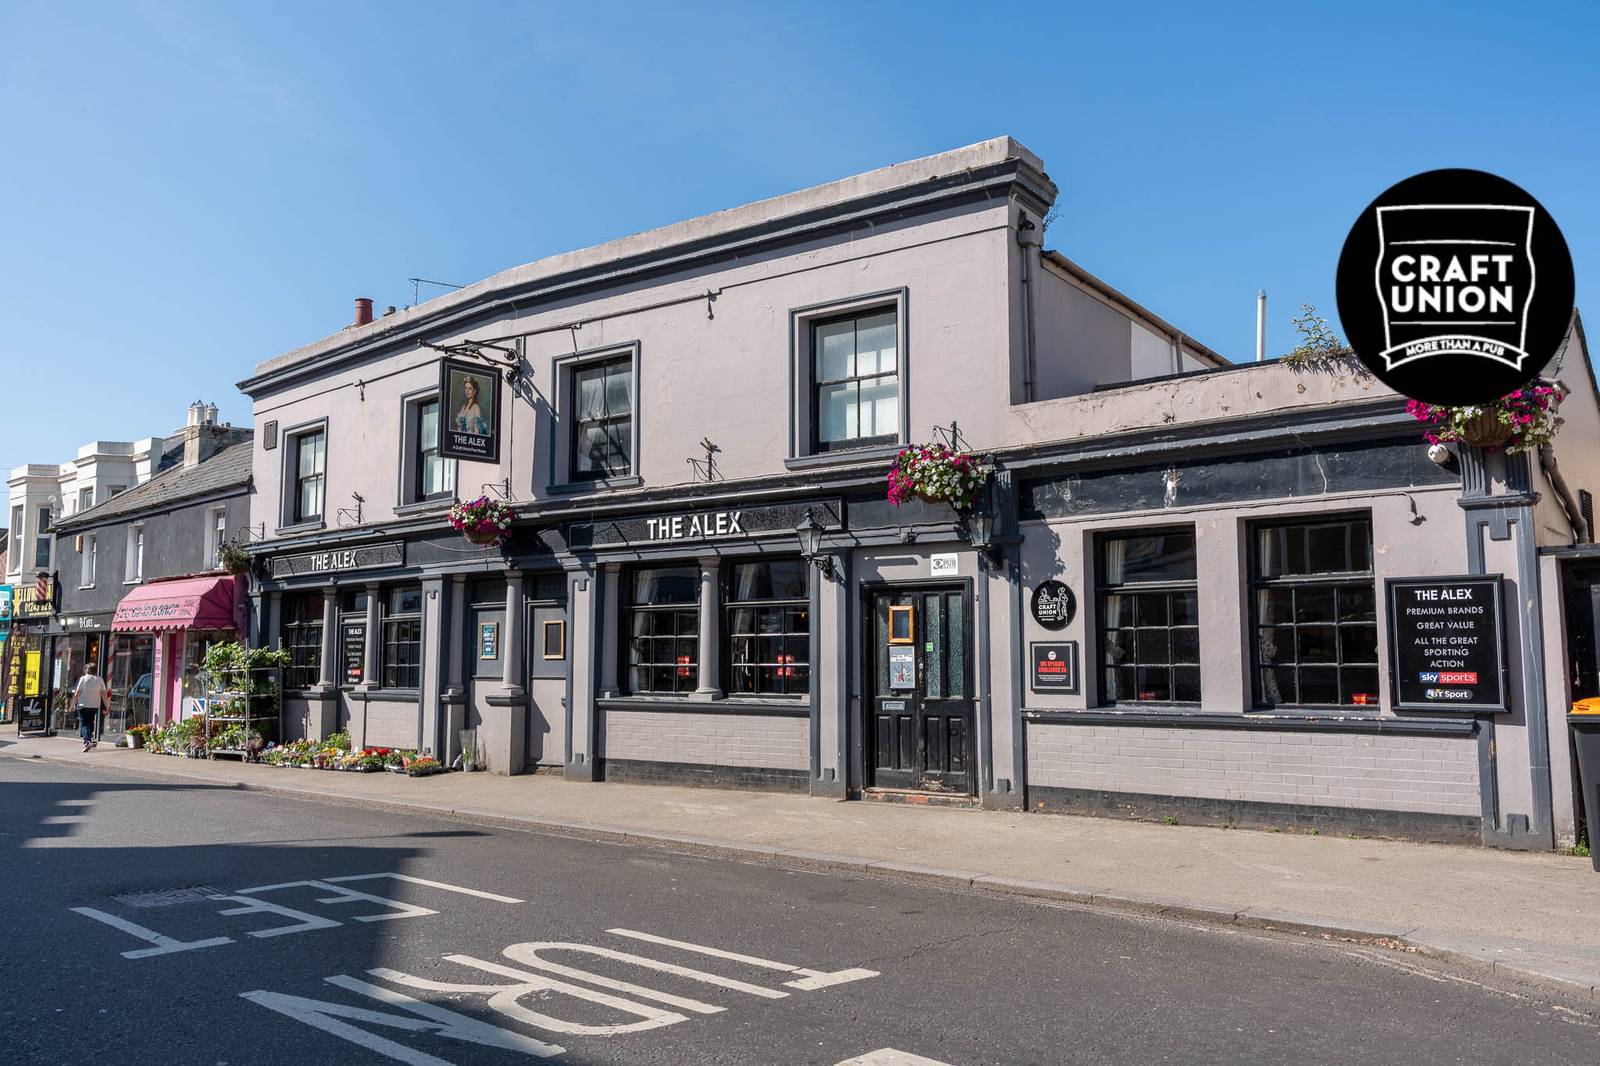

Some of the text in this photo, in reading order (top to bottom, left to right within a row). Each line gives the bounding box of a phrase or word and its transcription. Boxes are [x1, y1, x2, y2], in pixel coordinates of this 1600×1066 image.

[454, 435, 486, 447] THE ALEX
[646, 511, 742, 540] THE ALEX
[311, 550, 357, 571] THE ALEX
[1415, 588, 1473, 601] THE ALEX
[1406, 606, 1484, 616] PREMIUM BRANDS
[1416, 621, 1474, 630] GREAT VALUE
[1414, 636, 1478, 645] ALL THE GREAT
[1424, 648, 1469, 657] SPORTING
[1430, 659, 1464, 668] ACTION
[1421, 673, 1475, 683] sky sports
[1445, 690, 1468, 699] Sport
[70, 872, 525, 959] LEFT
[238, 928, 880, 1066] TURN
